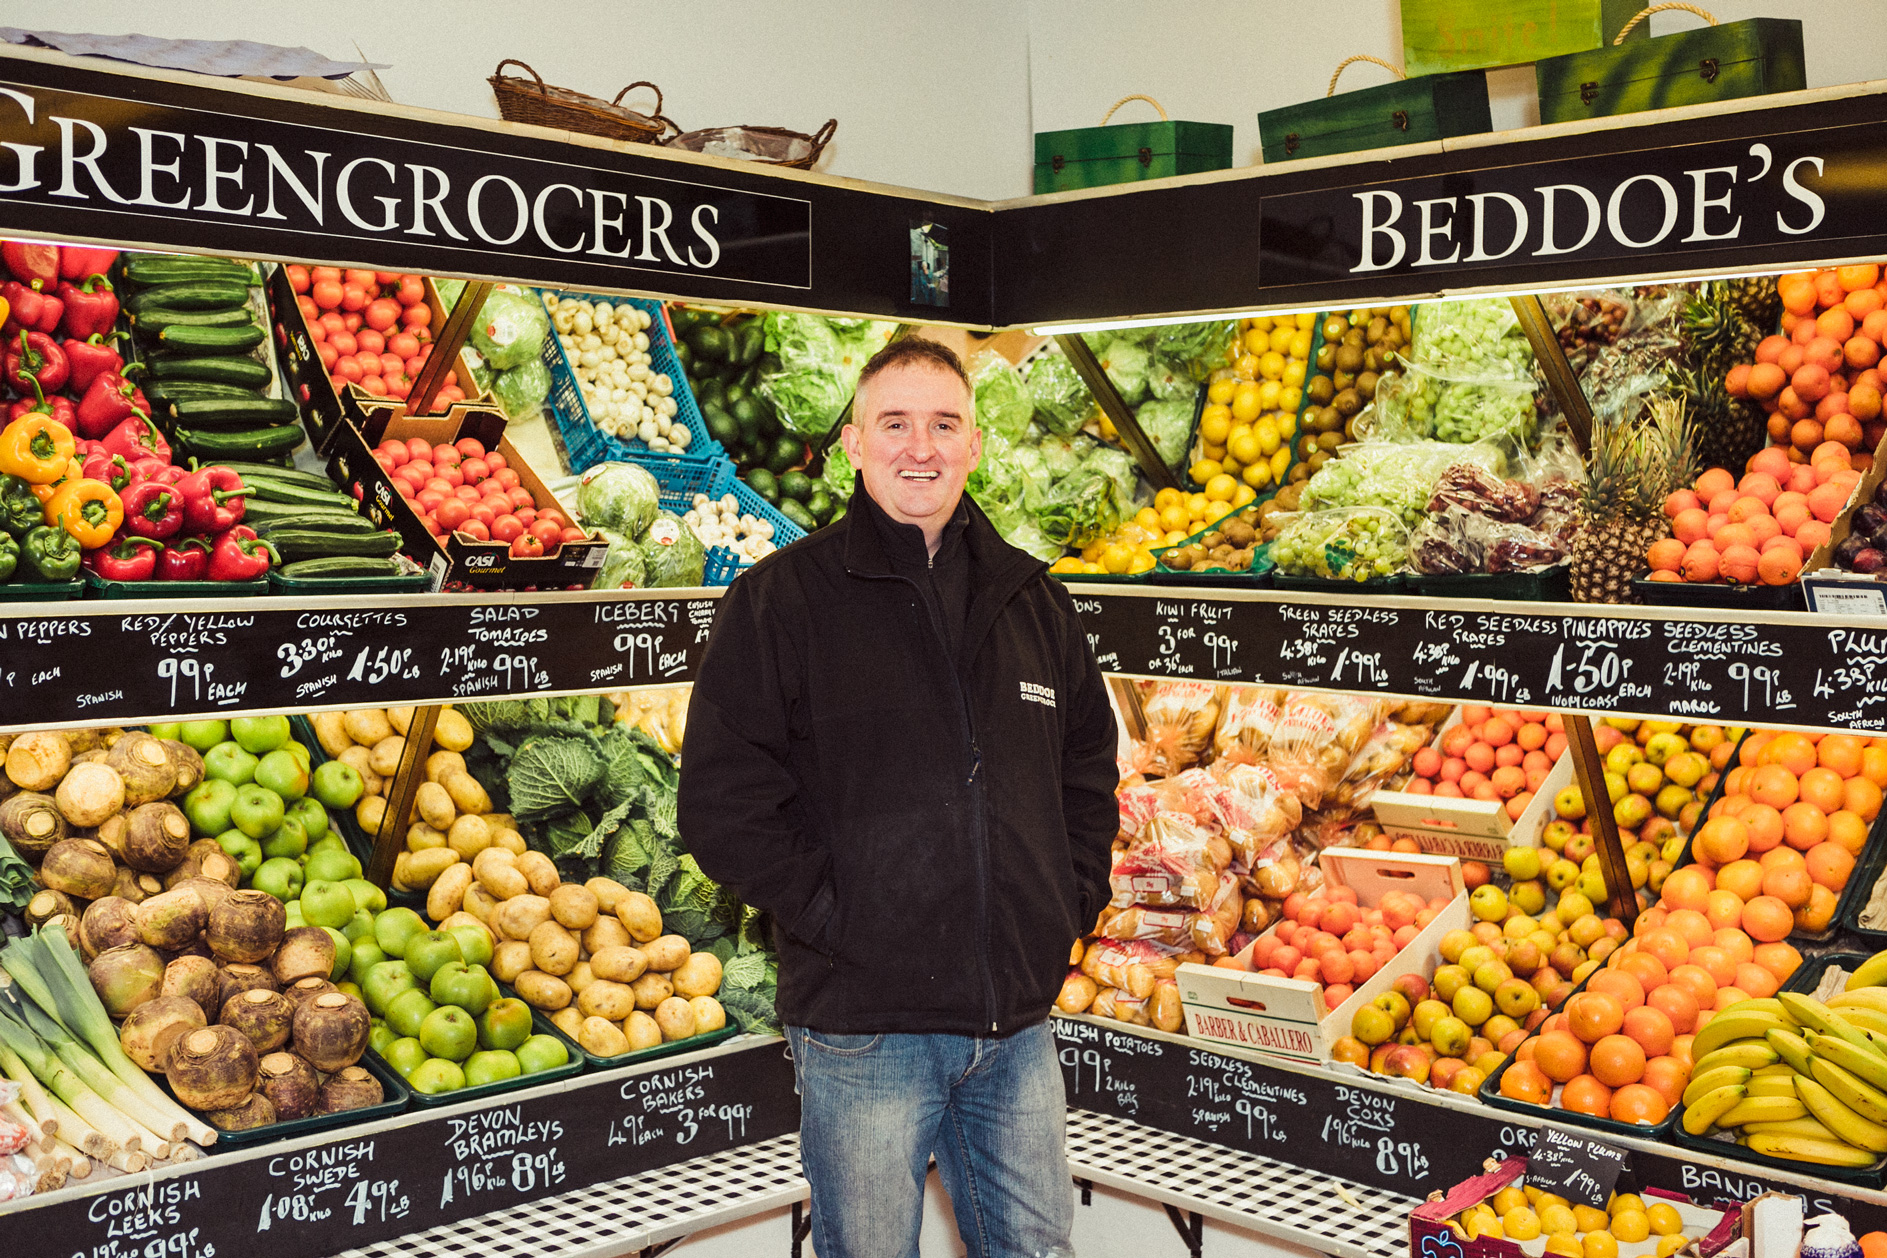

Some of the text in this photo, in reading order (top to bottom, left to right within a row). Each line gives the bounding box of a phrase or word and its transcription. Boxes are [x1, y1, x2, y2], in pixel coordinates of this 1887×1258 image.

[1350, 143, 1825, 273] BEDDOE'S
[375, 481, 390, 506] CASI
[465, 555, 495, 567] CASI
[469, 566, 506, 575] Gourmet
[297, 612, 407, 628] COURGETTES
[470, 607, 539, 624] SALAD
[595, 602, 679, 624] ICEBERG
[1157, 601, 1233, 620] KIWI FRUIT
[1279, 604, 1399, 625] GREEN SEEDLESS
[18, 621, 92, 639] PEPPERS
[1302, 622, 1359, 638] GRAPES
[1426, 611, 1558, 634] RED SEEDLESS
[1563, 617, 1652, 639] PINEAPPLES
[1663, 622, 1758, 640] SEEDLESS
[151, 632, 227, 647] PEPPERS
[468, 627, 548, 642] TOMATOES
[1158, 626, 1176, 655] 3
[1177, 628, 1196, 641] FOR
[1453, 629, 1505, 646] GRAPES
[322, 649, 343, 663] KILO
[1668, 639, 1783, 657] CLEMENTINES
[658, 650, 687, 672] EACH
[1148, 658, 1162, 670] OR
[1307, 655, 1327, 667] KILO
[31, 667, 61, 685] EACH
[402, 665, 420, 679] LB
[467, 659, 487, 671] KILO
[534, 671, 549, 683] LB
[590, 664, 623, 682] SPANISH
[208, 682, 247, 701] EACH
[296, 674, 337, 698] SPANISH
[452, 675, 497, 696] SPANISH
[1619, 683, 1652, 698] EACH
[1690, 679, 1713, 692] KILO
[1776, 690, 1792, 705] LB
[1866, 677, 1887, 693] KIL
[76, 690, 124, 708] SPANISH
[1552, 694, 1619, 709] IVORY COAST
[1670, 700, 1720, 714] MAROC
[1827, 709, 1863, 723] SOUTH
[1849, 717, 1885, 729] AFRICAN
[1050, 1018, 1163, 1056] ORNISH POTATOES
[1195, 1013, 1313, 1054] BARBER & CABALLERO
[1189, 1050, 1253, 1077] SEEDLESS
[620, 1066, 714, 1100] CORNISH
[1222, 1072, 1307, 1106] CLEMENTINES
[642, 1086, 705, 1113] BAKERS
[1118, 1093, 1138, 1109] BAG
[1335, 1086, 1395, 1112] DEVON
[444, 1105, 521, 1146] DEVON
[638, 1128, 664, 1146] EACH
[676, 1108, 699, 1144] 3
[698, 1104, 716, 1120] FOR
[1192, 1108, 1231, 1125] SPANISH
[1347, 1106, 1395, 1128] COXS
[454, 1120, 564, 1161] BRAMLEYS
[1546, 1129, 1622, 1160] YELLOW PLUMS
[269, 1141, 374, 1177] CORNISH
[293, 1163, 360, 1191] SWEDE
[486, 1173, 506, 1191] KILO
[1681, 1165, 1837, 1214] BANAAS
[89, 1180, 201, 1223] CORNISH
[107, 1205, 181, 1238] LEEKS
[309, 1207, 331, 1222] KILO
